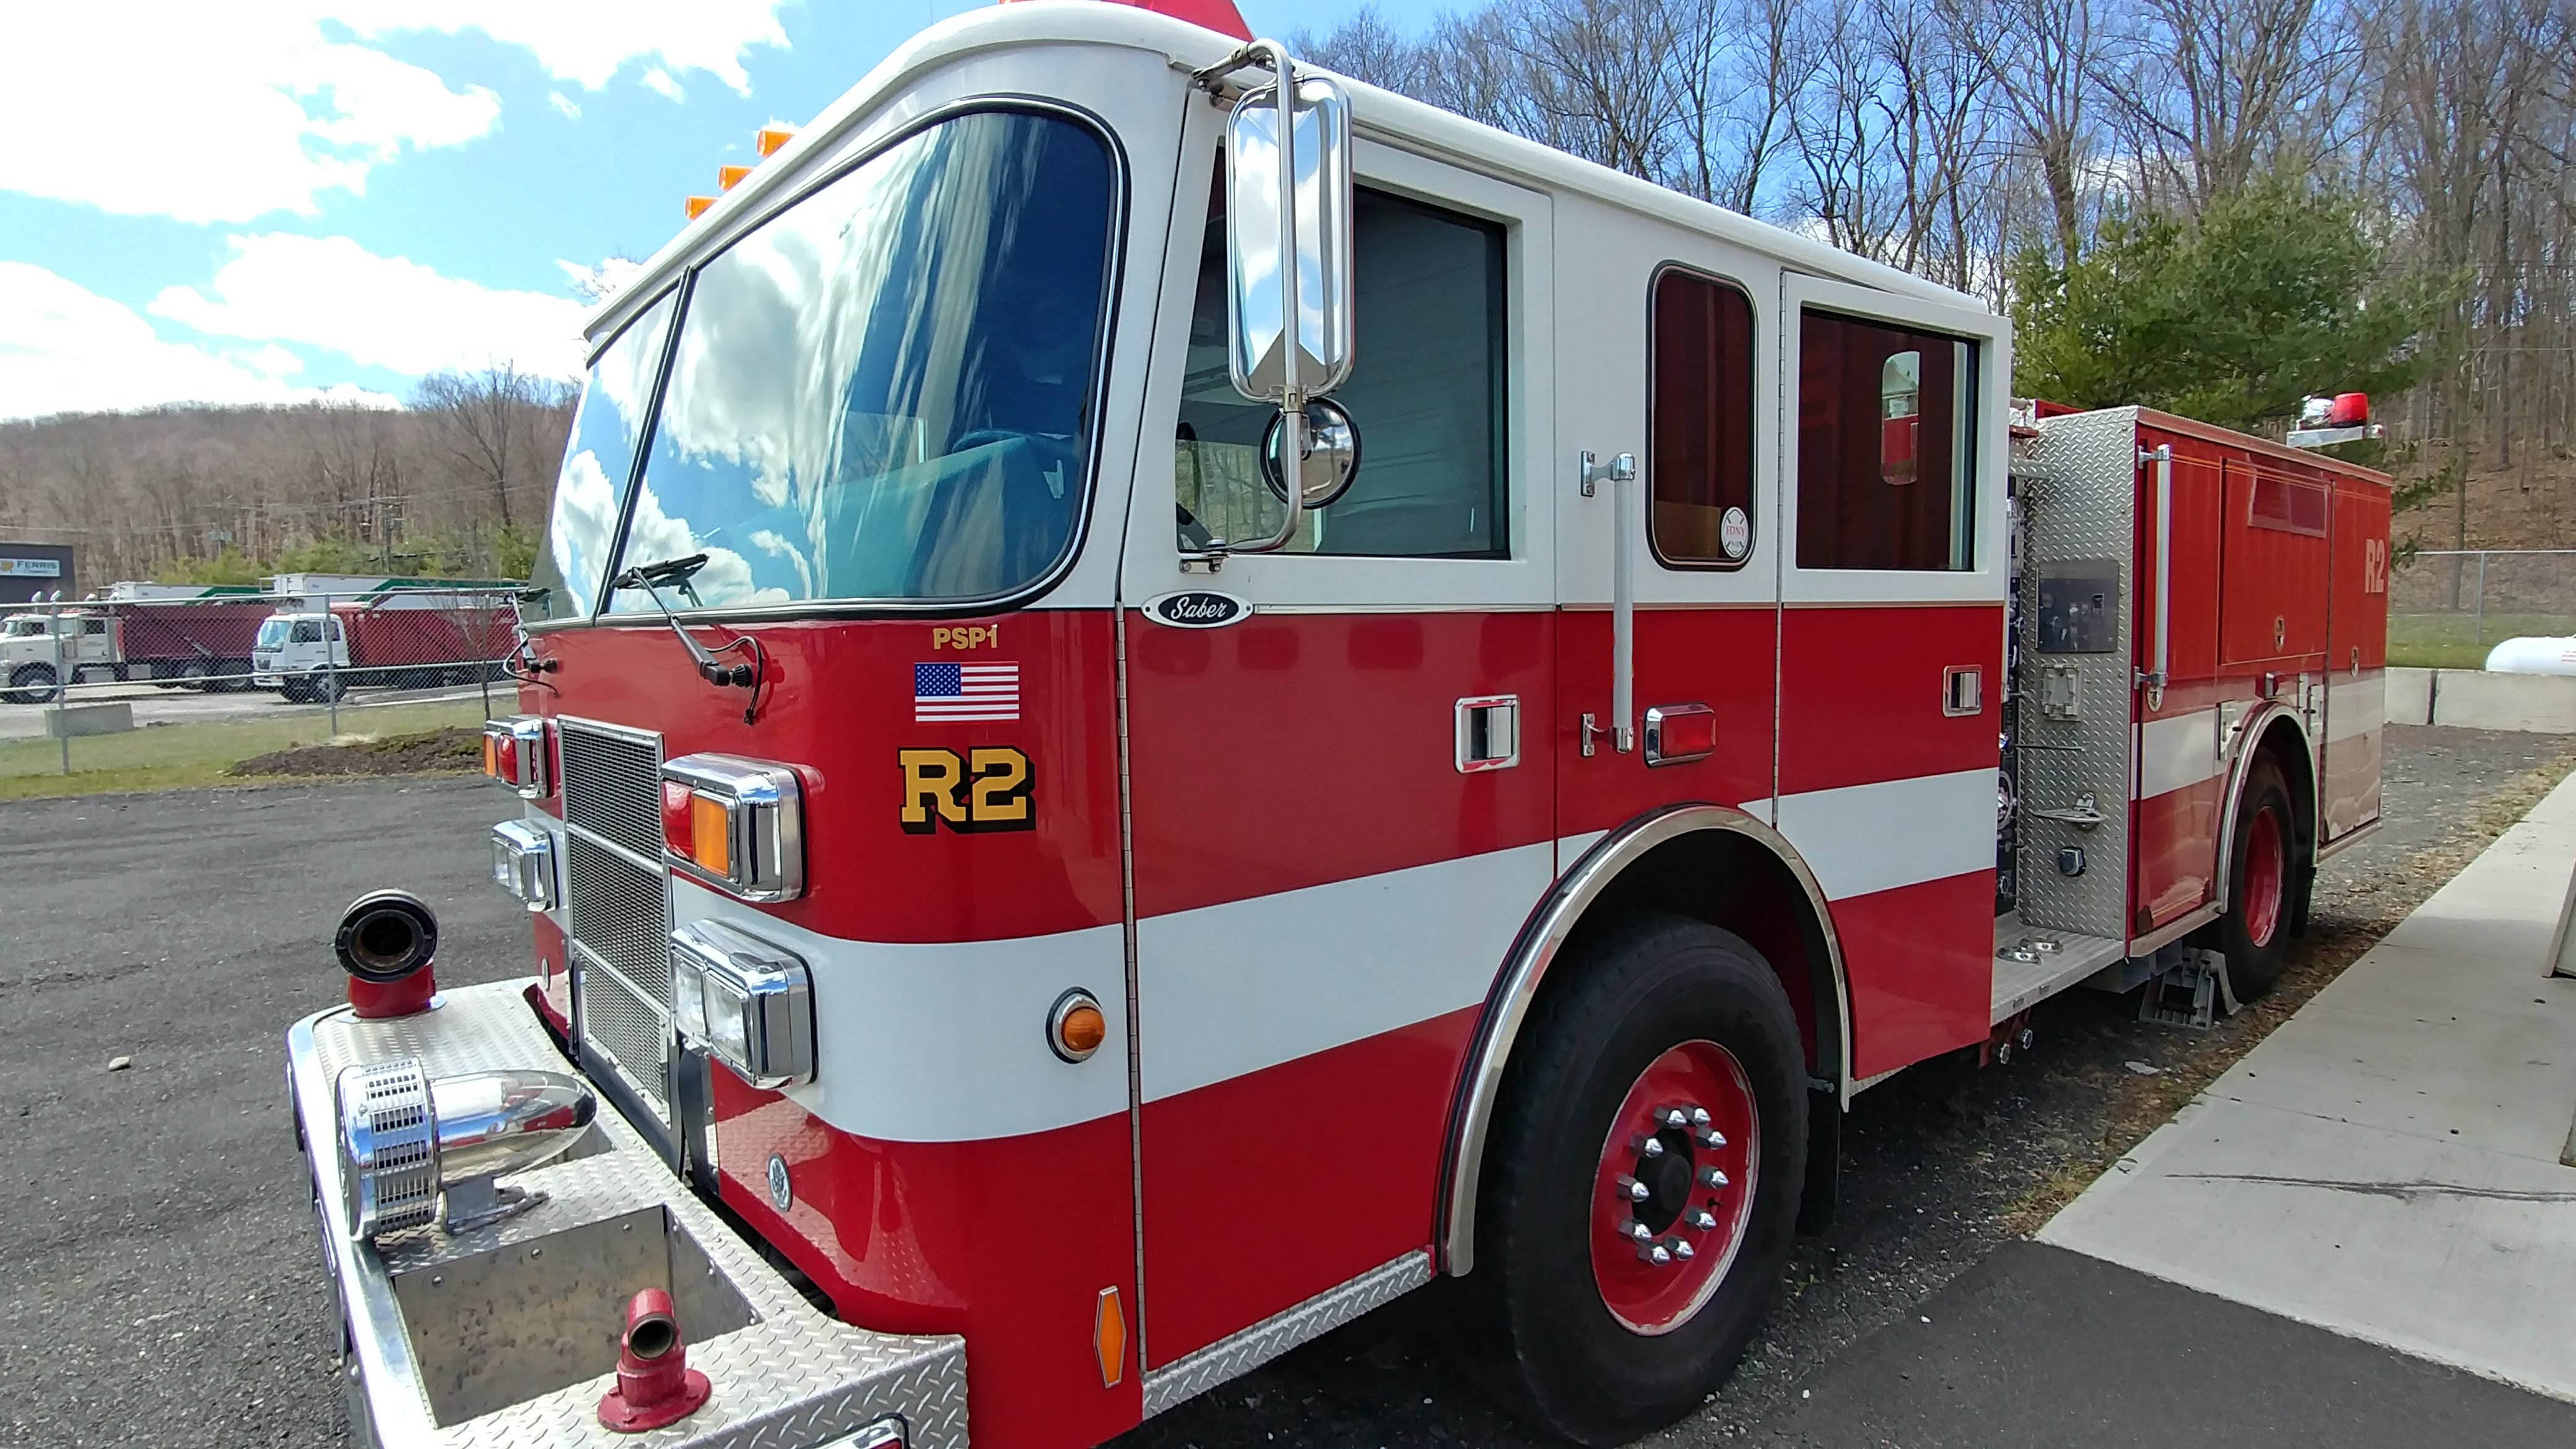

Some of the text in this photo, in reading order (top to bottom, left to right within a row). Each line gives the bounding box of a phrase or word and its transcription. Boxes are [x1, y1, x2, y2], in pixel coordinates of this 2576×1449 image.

[1726, 526, 1745, 537] FDNY
[17, 560, 57, 569] FERRIS
[2364, 539, 2385, 594] R2
[1170, 596, 1227, 620] Saber
[933, 624, 998, 650] PSP1
[898, 745, 1035, 833] R2
